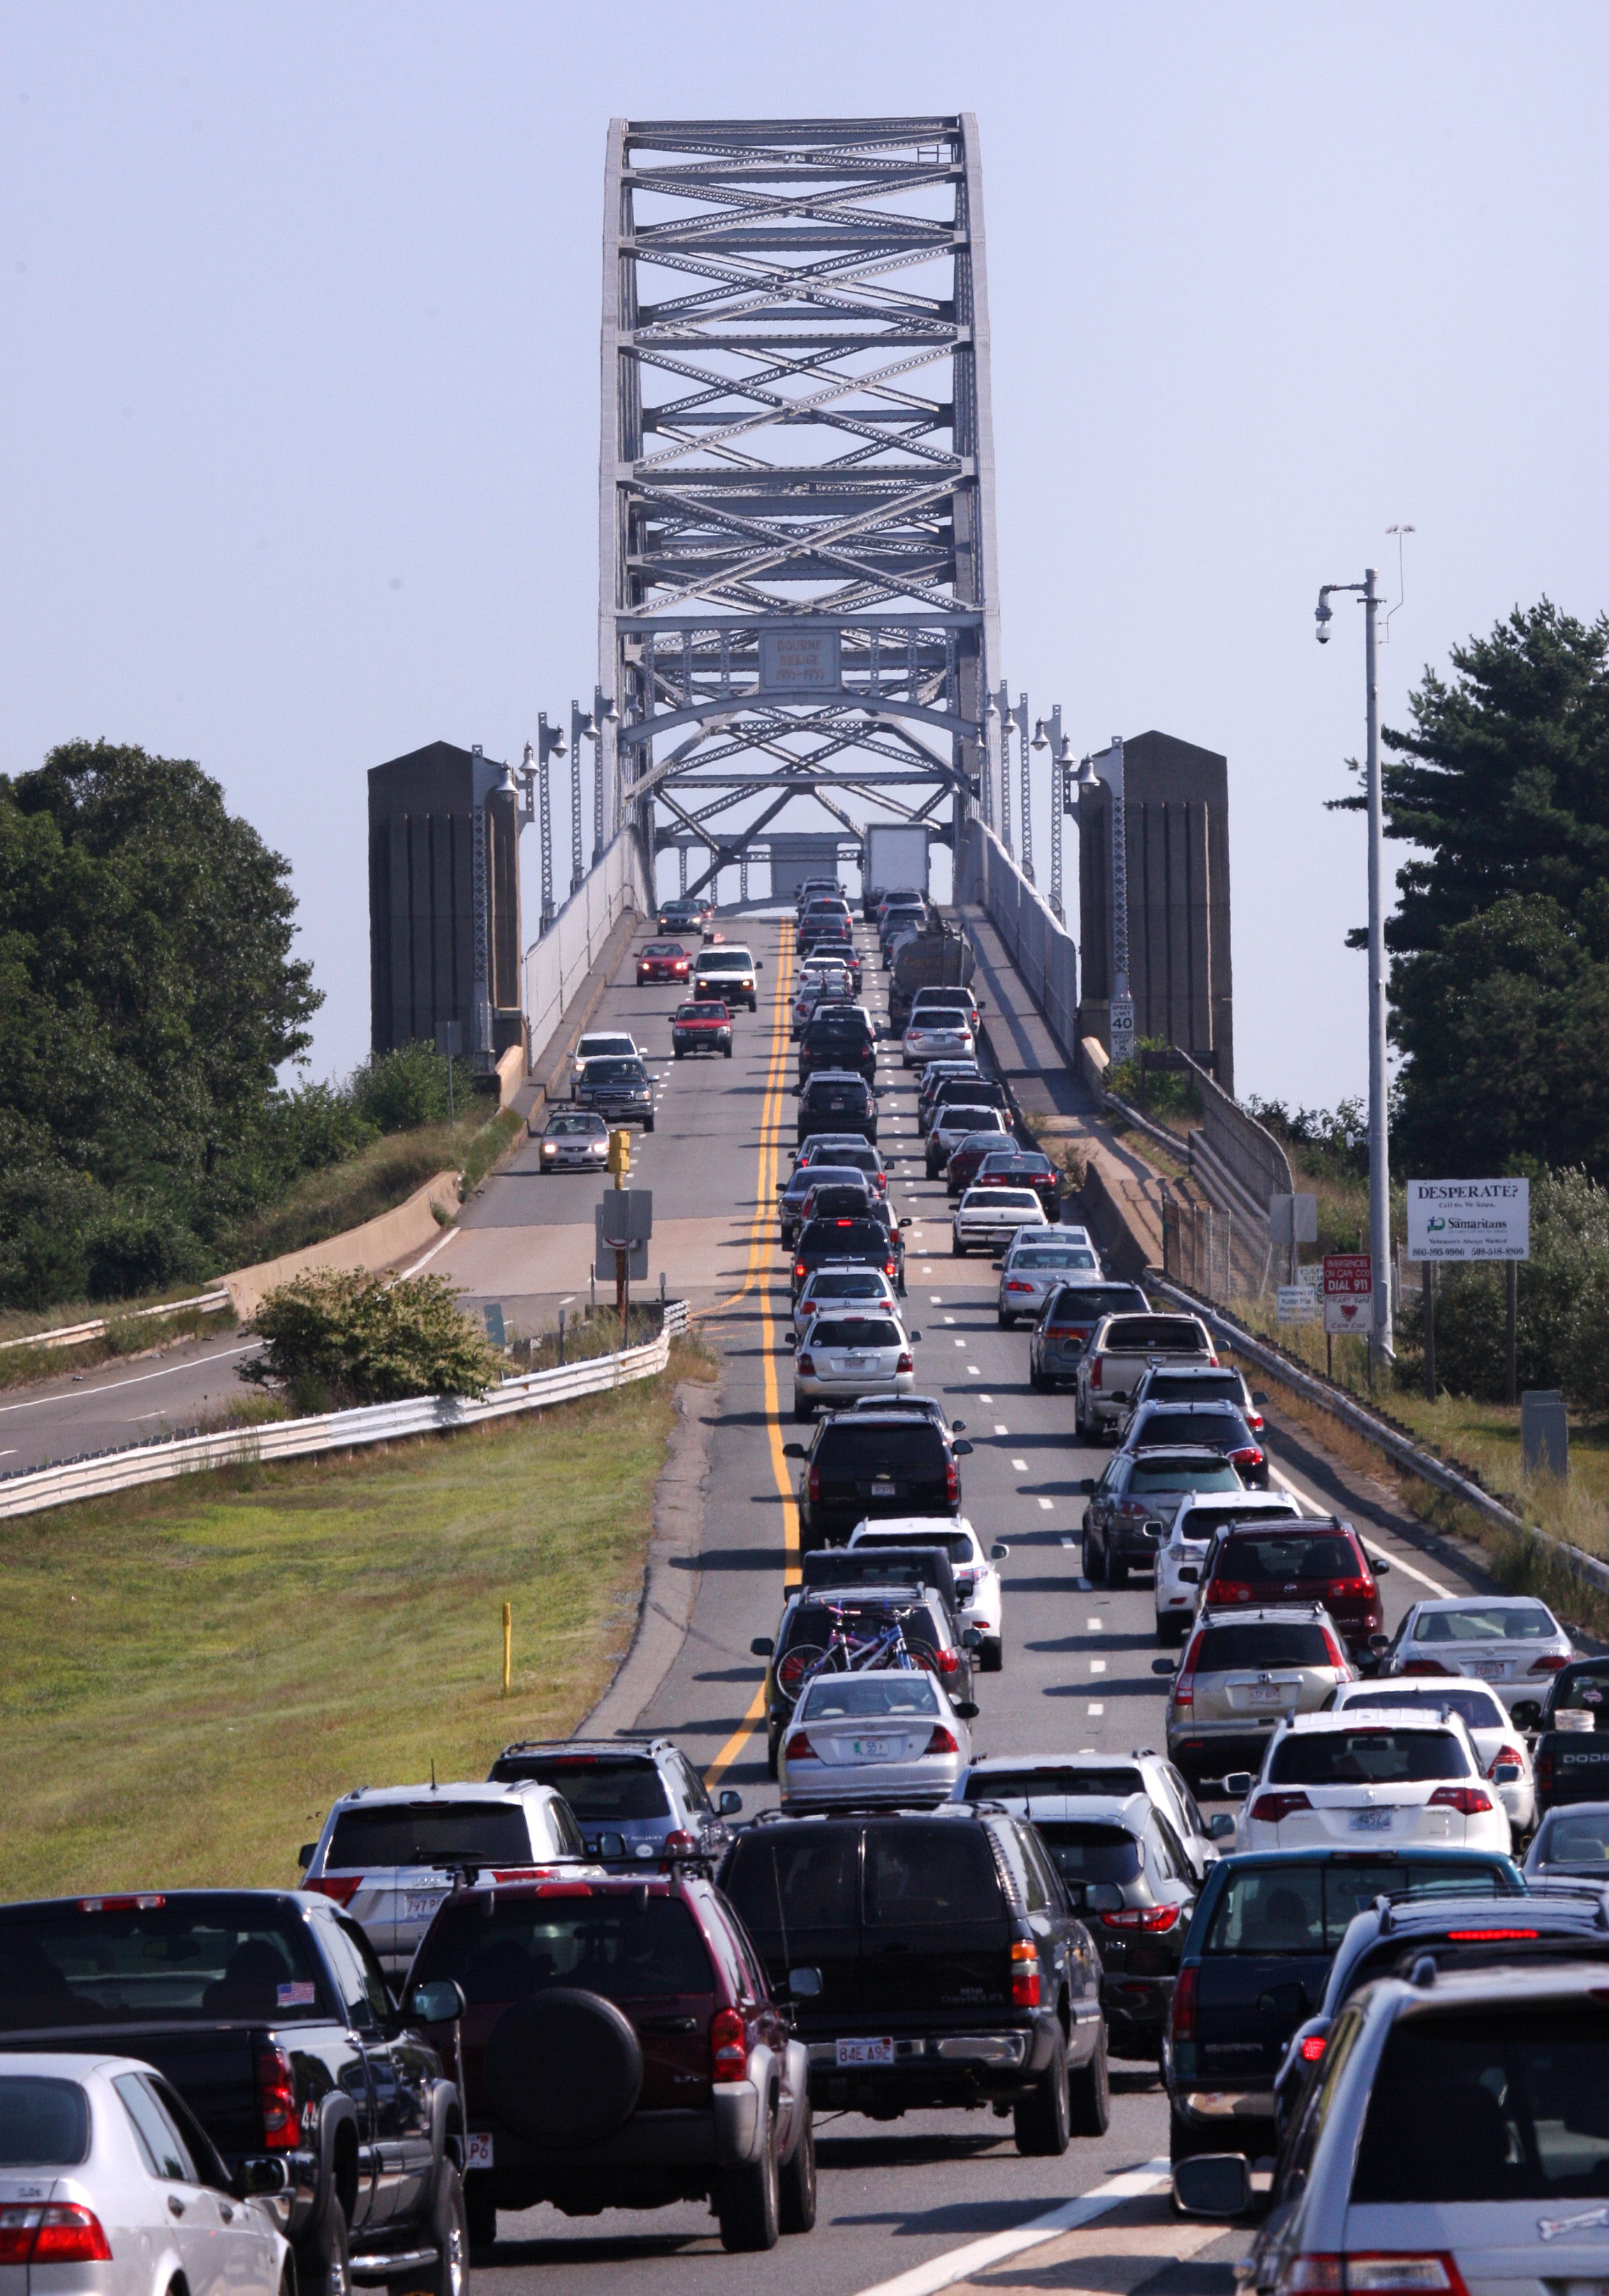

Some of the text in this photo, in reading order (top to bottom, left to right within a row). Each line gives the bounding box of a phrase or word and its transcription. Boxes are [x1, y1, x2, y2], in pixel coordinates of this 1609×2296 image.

[1112, 1017, 1132, 1029] 40
[1418, 1185, 1518, 1199] DESPERATE?
[1448, 1218, 1507, 1229] Samaritans
[1328, 1279, 1368, 1291] DIAL 911
